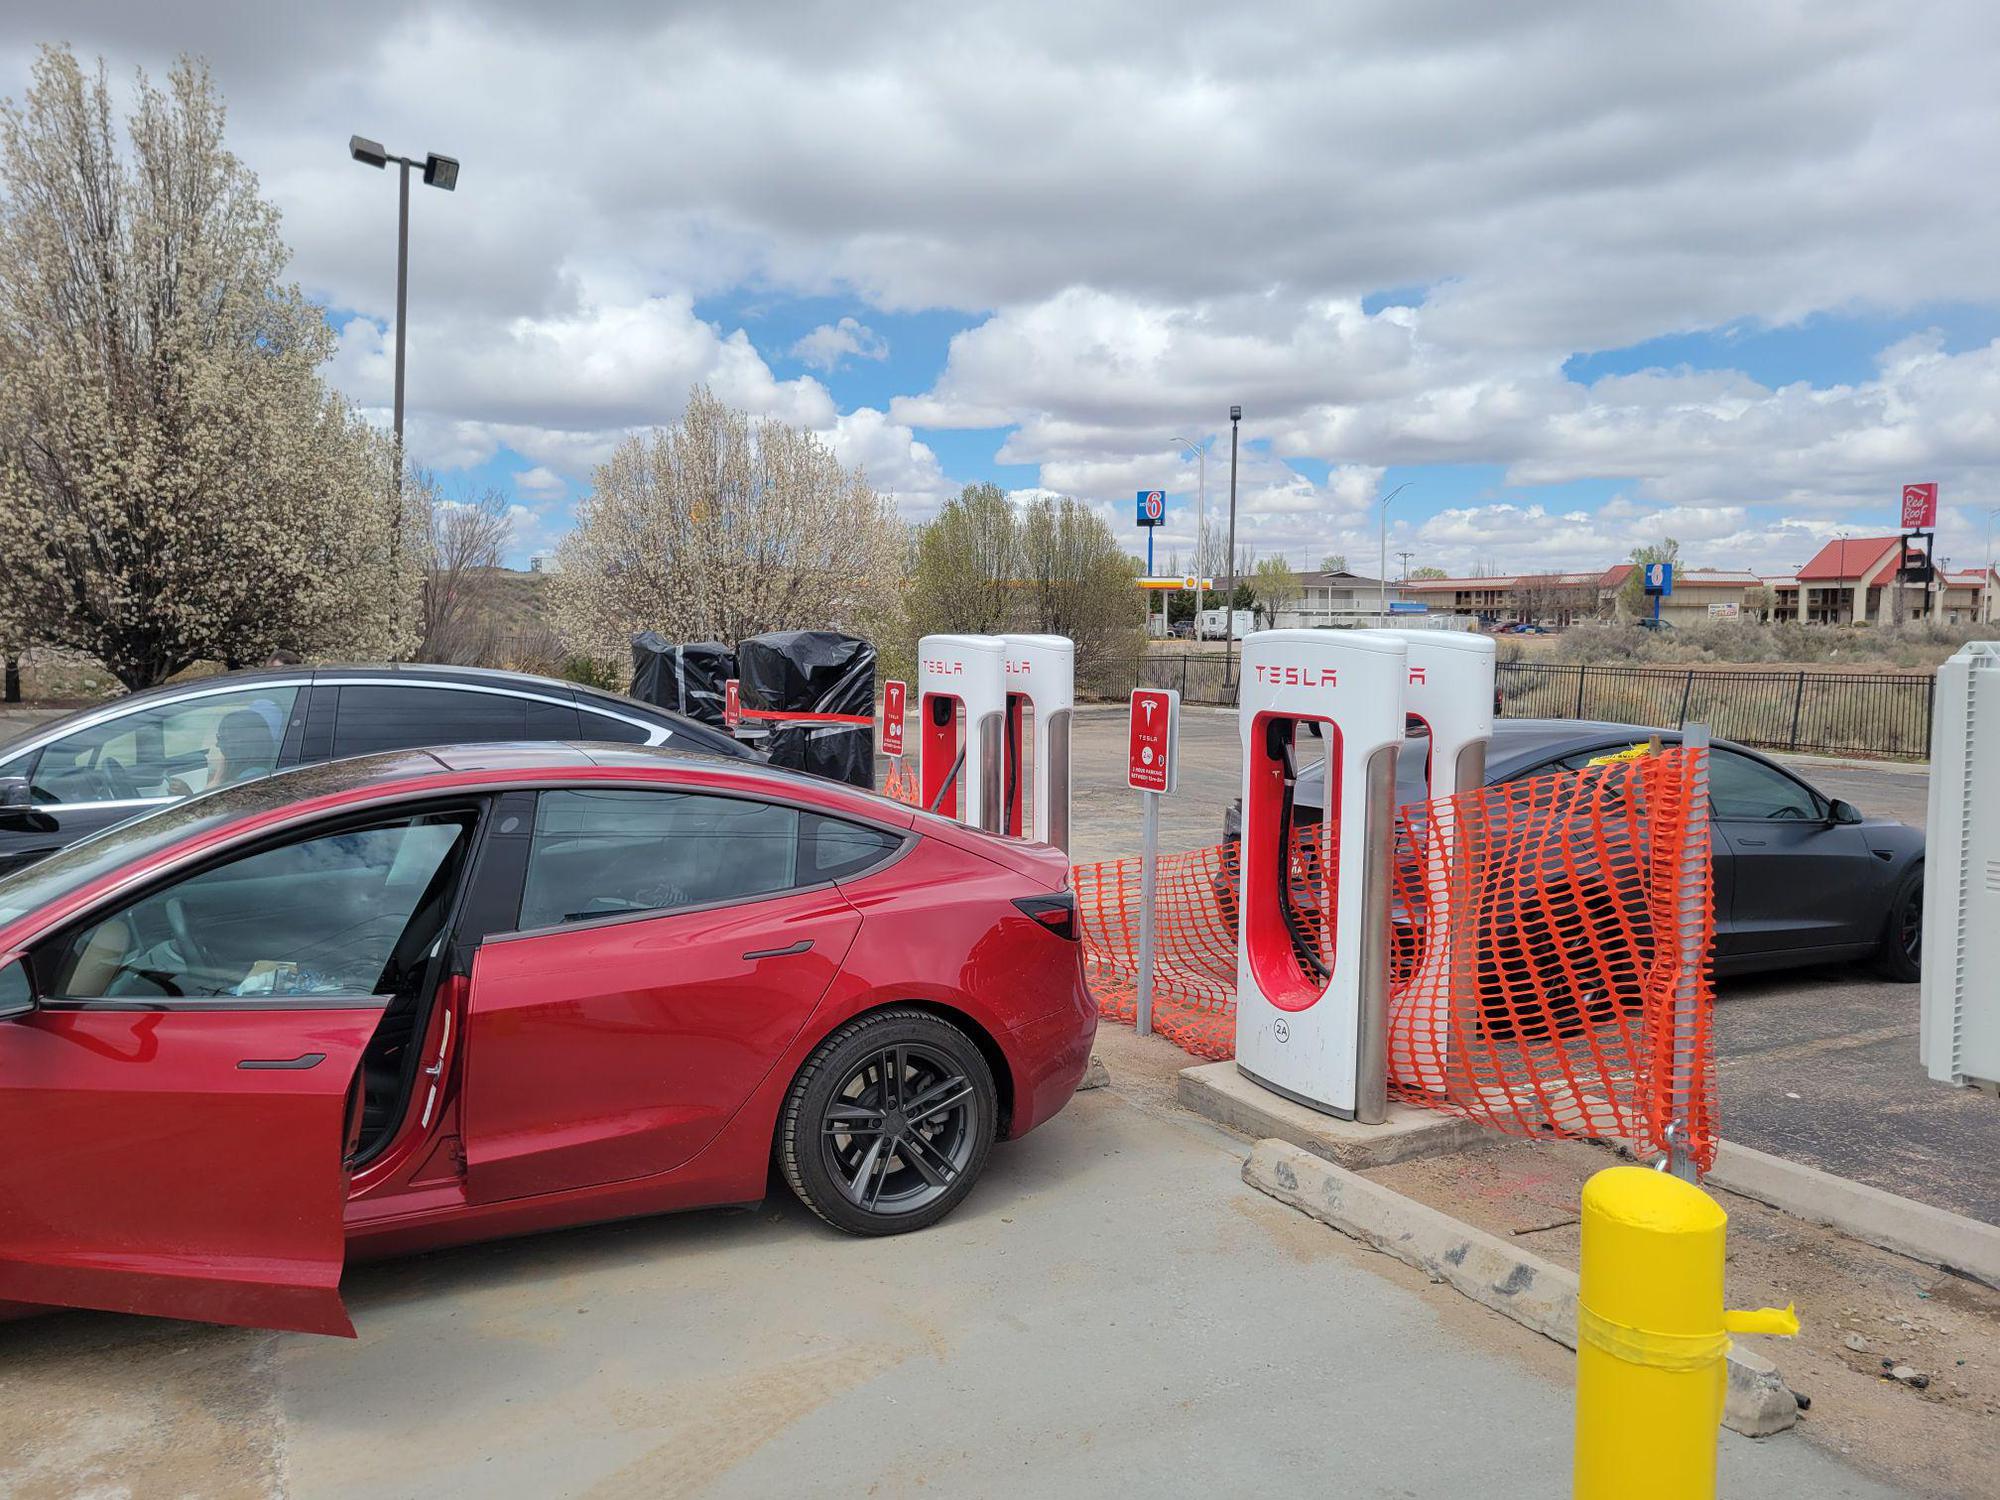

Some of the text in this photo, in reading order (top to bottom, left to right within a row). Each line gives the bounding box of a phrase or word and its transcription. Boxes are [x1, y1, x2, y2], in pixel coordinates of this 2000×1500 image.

[1146, 491, 1162, 519] 6
[1906, 495, 1925, 508] Red
[1904, 504, 1928, 520] Roof
[922, 660, 962, 675] TESLA
[1006, 660, 1031, 674] SLA
[1255, 665, 1337, 688] TESLA
[1138, 734, 1158, 742] TESLA
[1276, 1024, 1288, 1036] 2A
